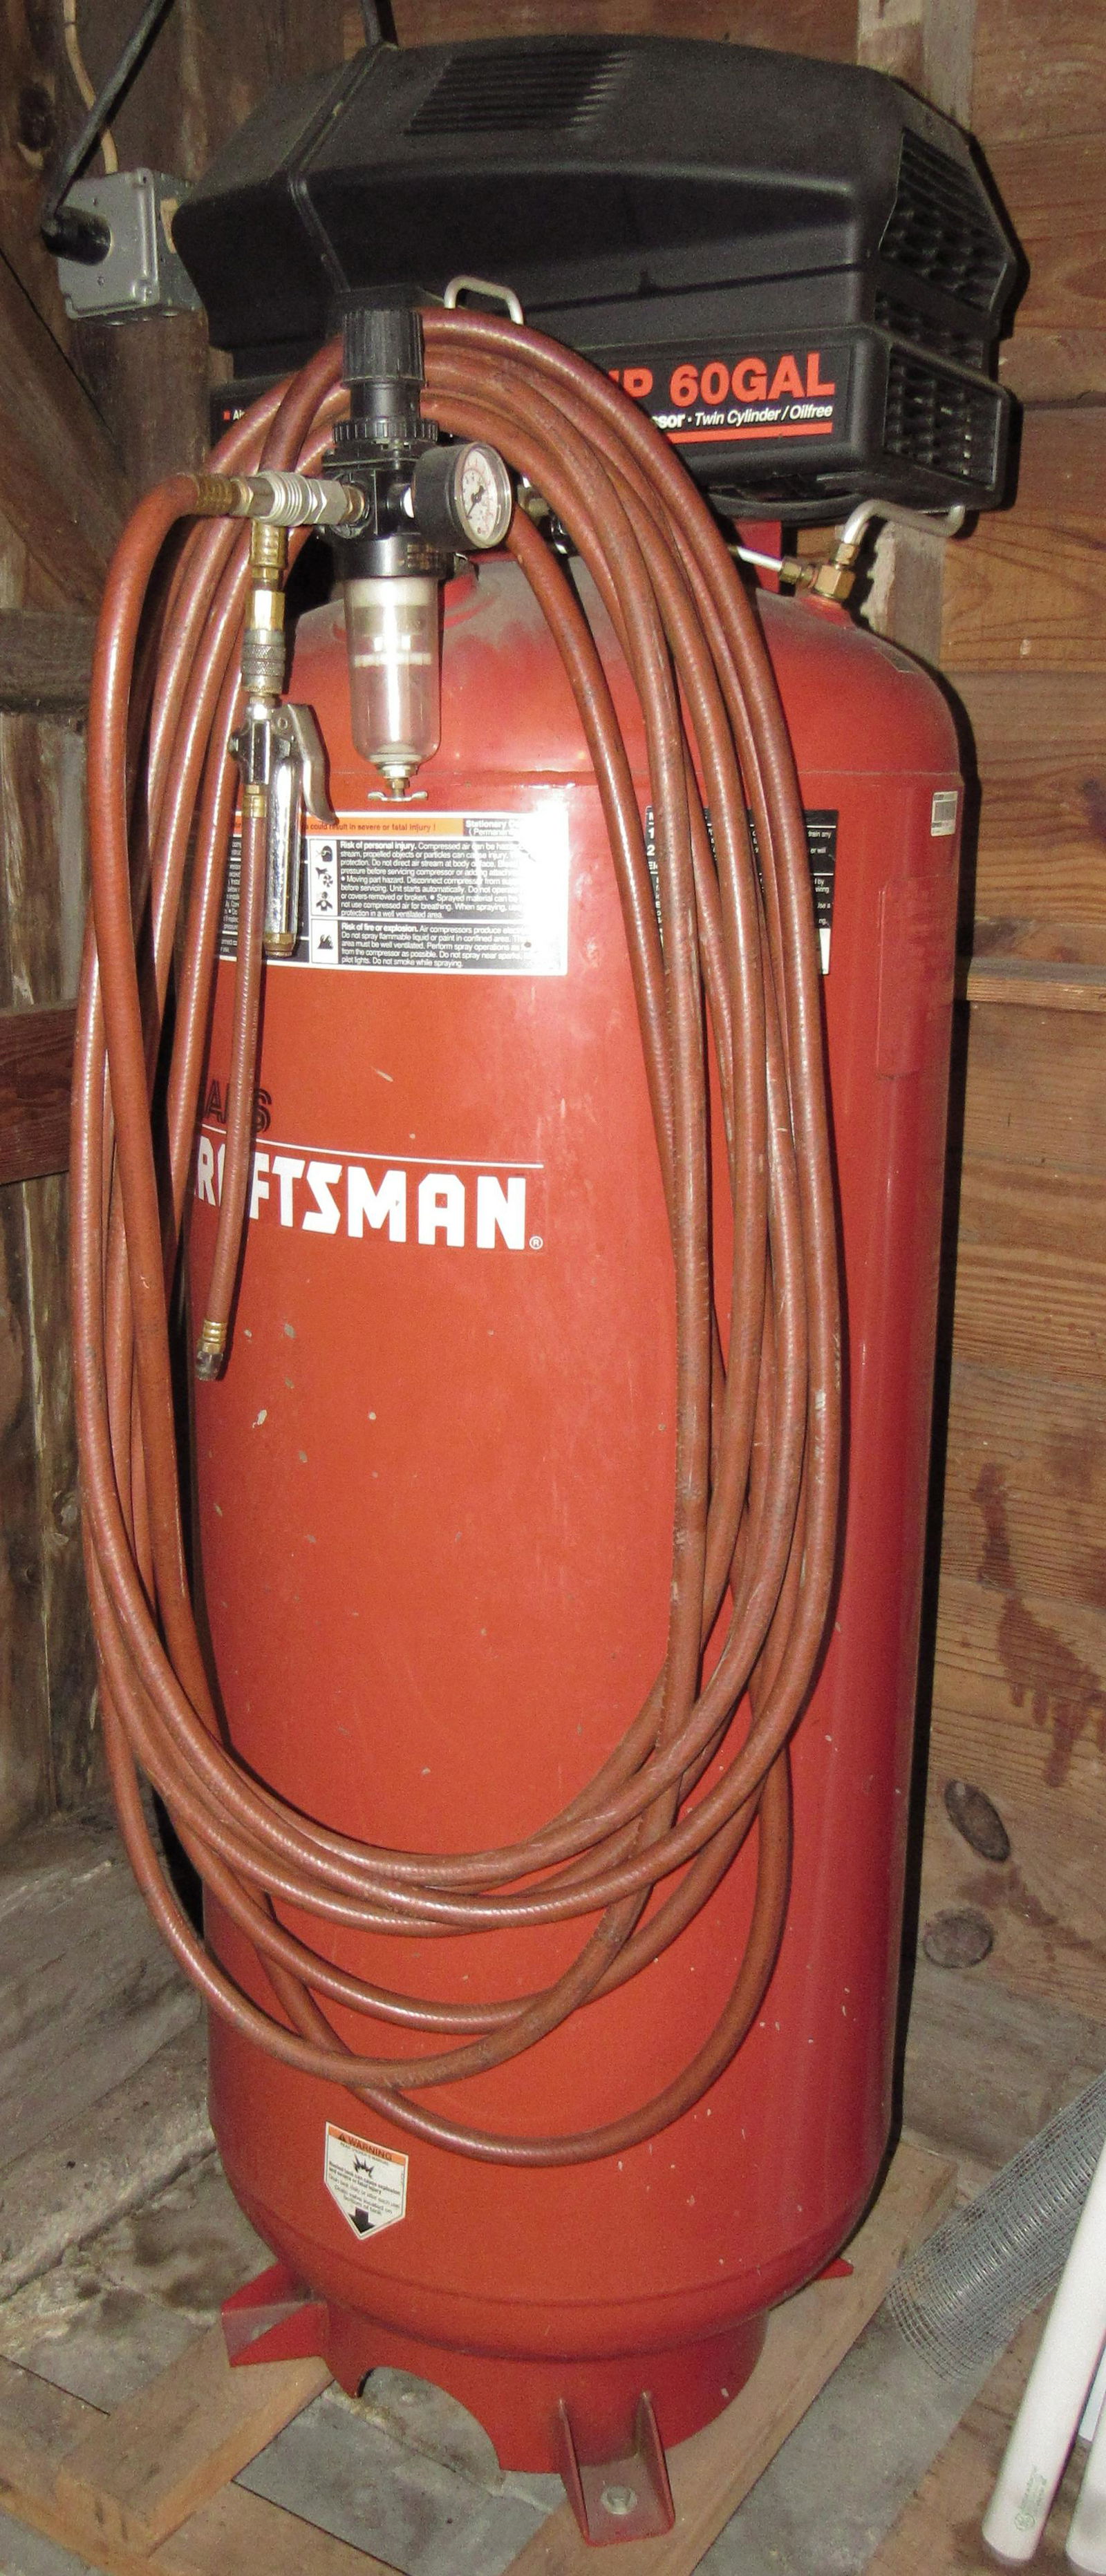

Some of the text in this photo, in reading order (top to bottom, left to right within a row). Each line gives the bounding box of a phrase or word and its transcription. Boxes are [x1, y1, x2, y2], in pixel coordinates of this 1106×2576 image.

[669, 351, 835, 407] 60GAL
[695, 410, 724, 426] Twin
[727, 407, 780, 426] Cylinder
[789, 404, 833, 420] Oilfree
[340, 841, 355, 849] Risk
[355, 841, 363, 849] of
[364, 842, 394, 850] personal
[395, 842, 417, 851] injury.
[418, 842, 460, 851] Compressed
[363, 851, 391, 859] propelled
[392, 851, 414, 860] objects
[424, 851, 451, 860] particles
[453, 860, 469, 869] body
[387, 869, 415, 877] servicing
[415, 869, 456, 878] compressor
[346, 875, 368, 884] Moving
[389, 884, 402, 893] Unit
[436, 894, 465, 902] Sprayed
[363, 902, 401, 910] compressed
[420, 902, 453, 911] breathing.
[341, 922, 356, 930] Risk
[356, 922, 364, 931] of
[364, 922, 374, 931] fire
[383, 924, 419, 934] explosion.
[420, 925, 429, 933] Air
[429, 927, 472, 935] compressors
[474, 926, 502, 934] produce
[351, 931, 361, 940] not
[361, 933, 378, 941] spray
[379, 932, 412, 940] flammable
[412, 933, 429, 942] liquid
[438, 934, 455, 943] paint
[463, 934, 493, 943] confined
[427, 943, 453, 951] Perform
[453, 944, 474, 952] spray
[474, 943, 510, 952] operations
[365, 949, 401, 958] compressor
[410, 950, 438, 959] possible.
[439, 950, 449, 958] Do
[450, 951, 461, 959] not
[461, 952, 481, 961] spray
[341, 956, 354, 965] pilot
[415, 958, 433, 967] while
[433, 960, 464, 969] spraying.
[349, 2136, 393, 2161] WARNING
